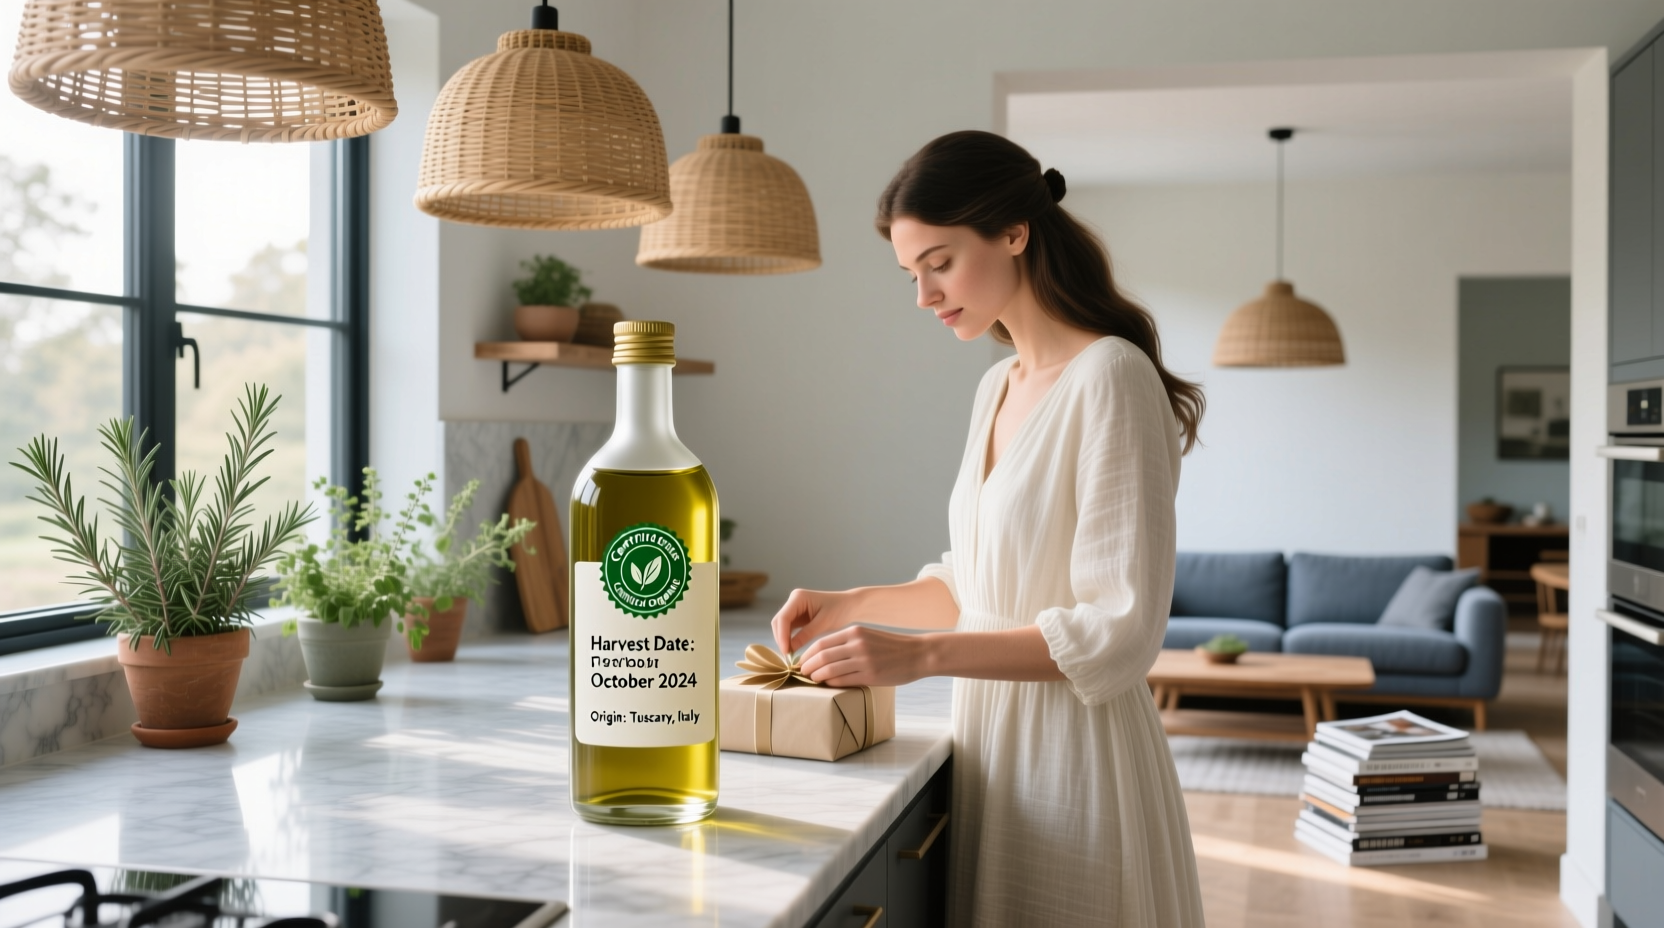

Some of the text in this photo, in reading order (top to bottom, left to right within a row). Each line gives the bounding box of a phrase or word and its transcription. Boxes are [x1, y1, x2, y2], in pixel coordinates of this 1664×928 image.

[591, 635, 695, 651] Harvest Date:
[591, 672, 698, 689] October 2024
[590, 711, 626, 726] Origin:
